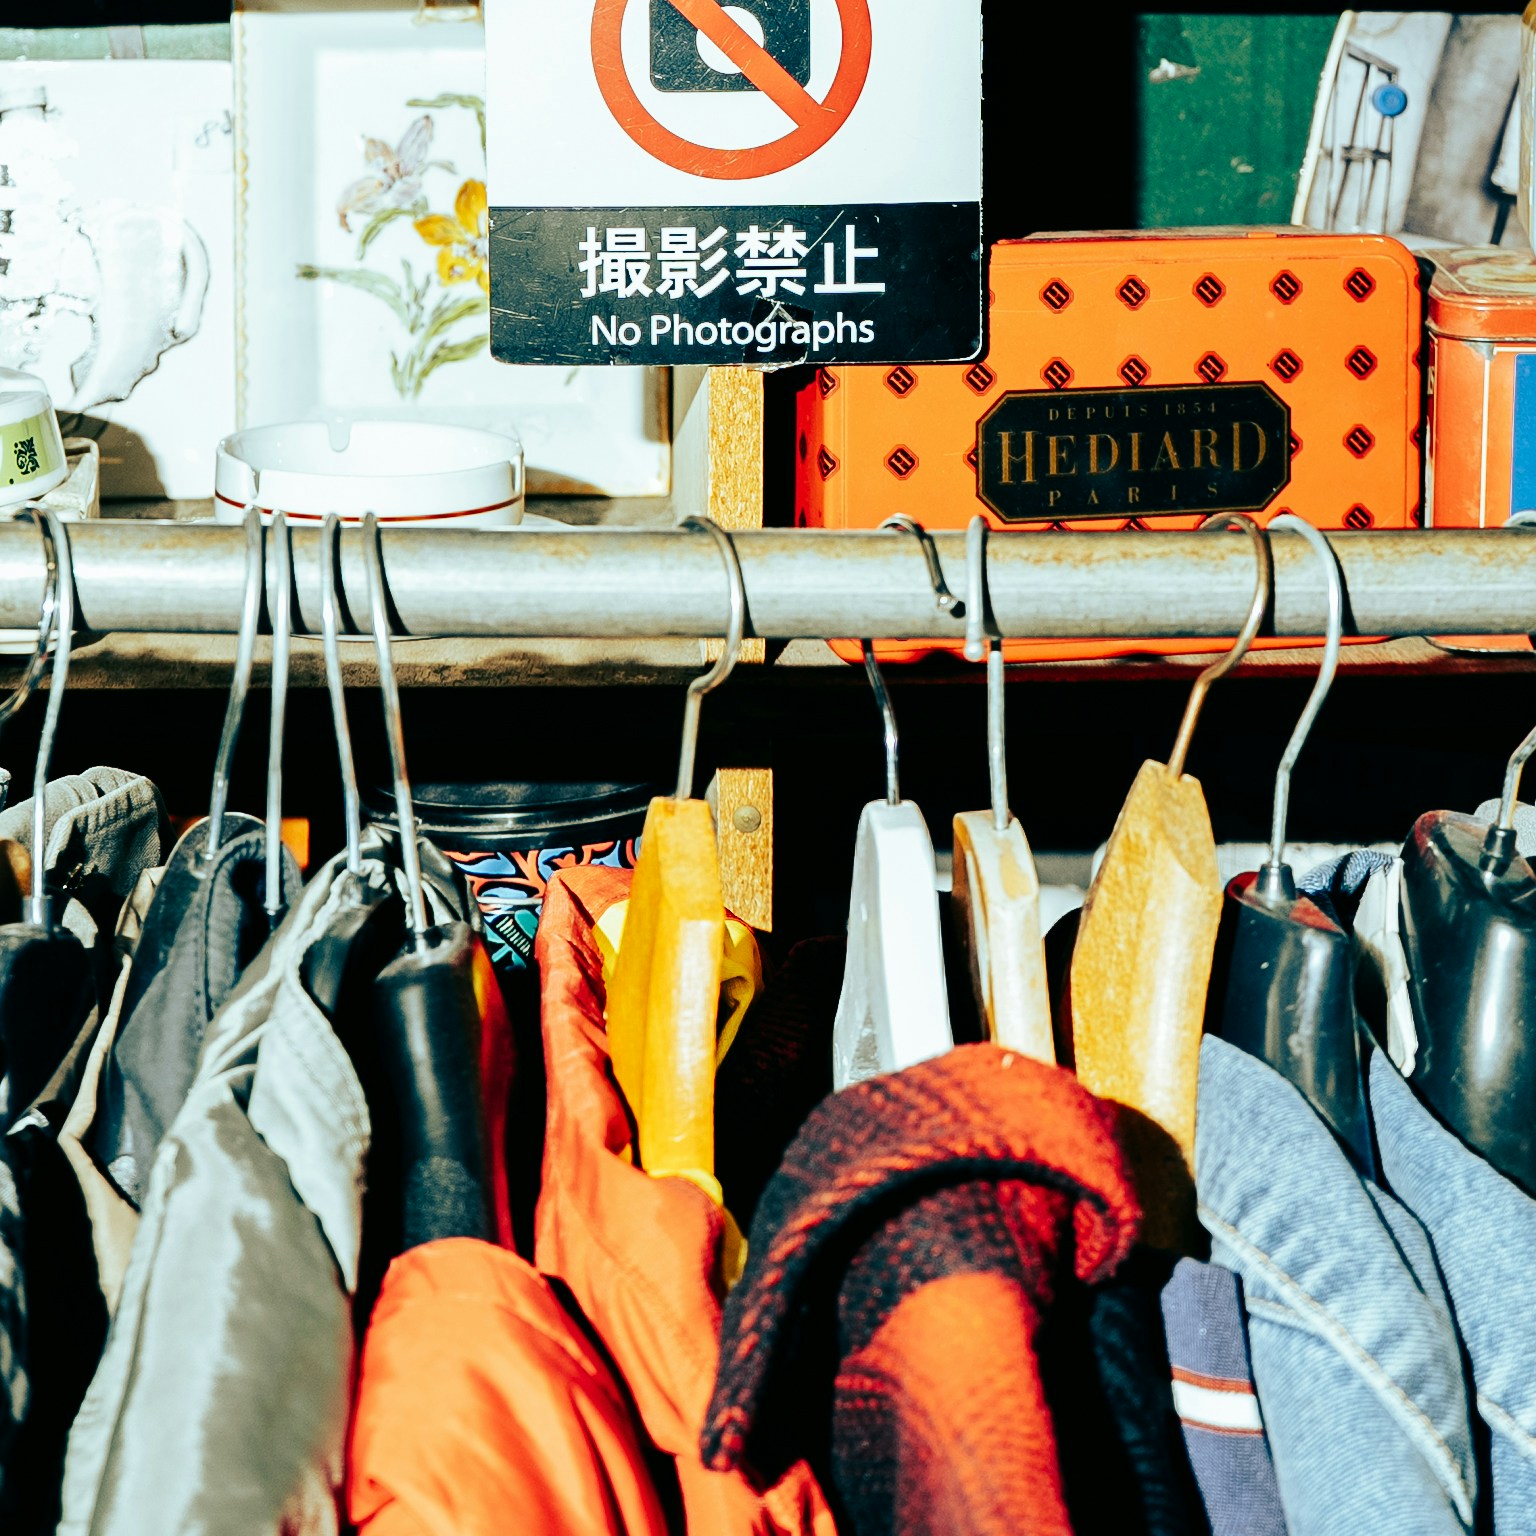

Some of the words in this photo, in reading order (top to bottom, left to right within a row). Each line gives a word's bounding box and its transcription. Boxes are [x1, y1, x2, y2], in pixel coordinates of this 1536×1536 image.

[578, 224, 886, 299] 撮影禁止
[592, 314, 641, 346] No
[650, 309, 875, 353] Photographs
[1048, 402, 1150, 421] DEPUIS
[1164, 401, 1218, 416] 1854
[997, 419, 1267, 486] HEDIARD
[1048, 483, 1220, 509] PARIS
